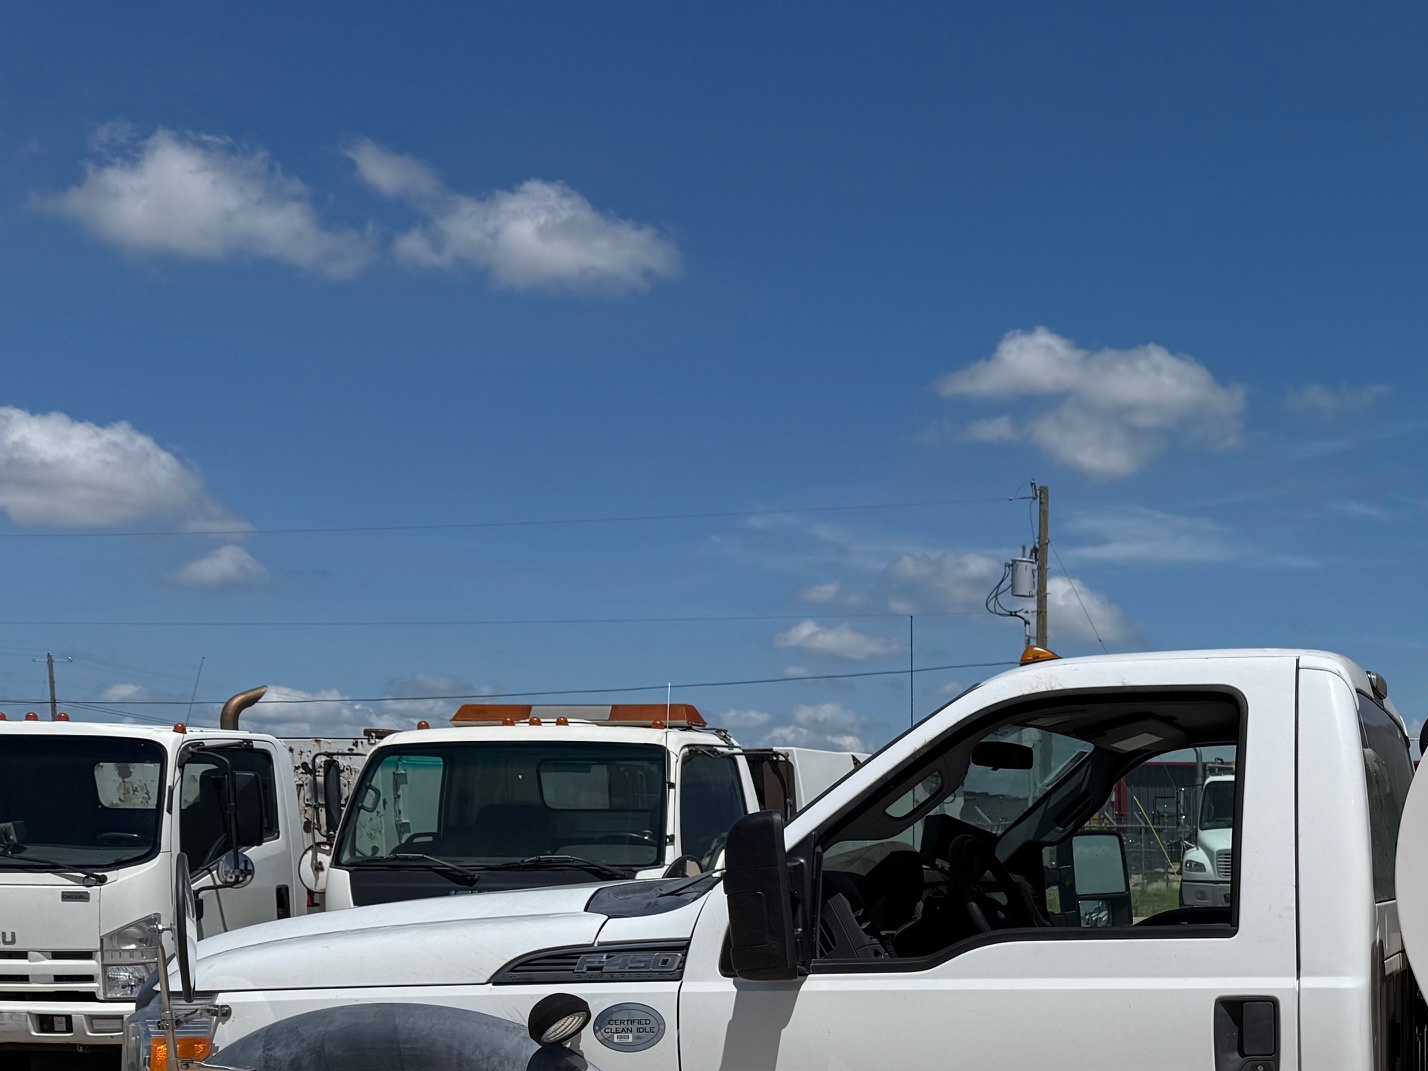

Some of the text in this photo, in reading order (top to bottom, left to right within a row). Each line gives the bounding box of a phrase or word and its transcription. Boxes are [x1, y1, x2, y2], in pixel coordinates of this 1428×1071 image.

[0, 931, 16, 945] U
[573, 952, 683, 973] F-450
[608, 1018, 651, 1026] CERTIFIED
[636, 1026, 656, 1034] IDLE
